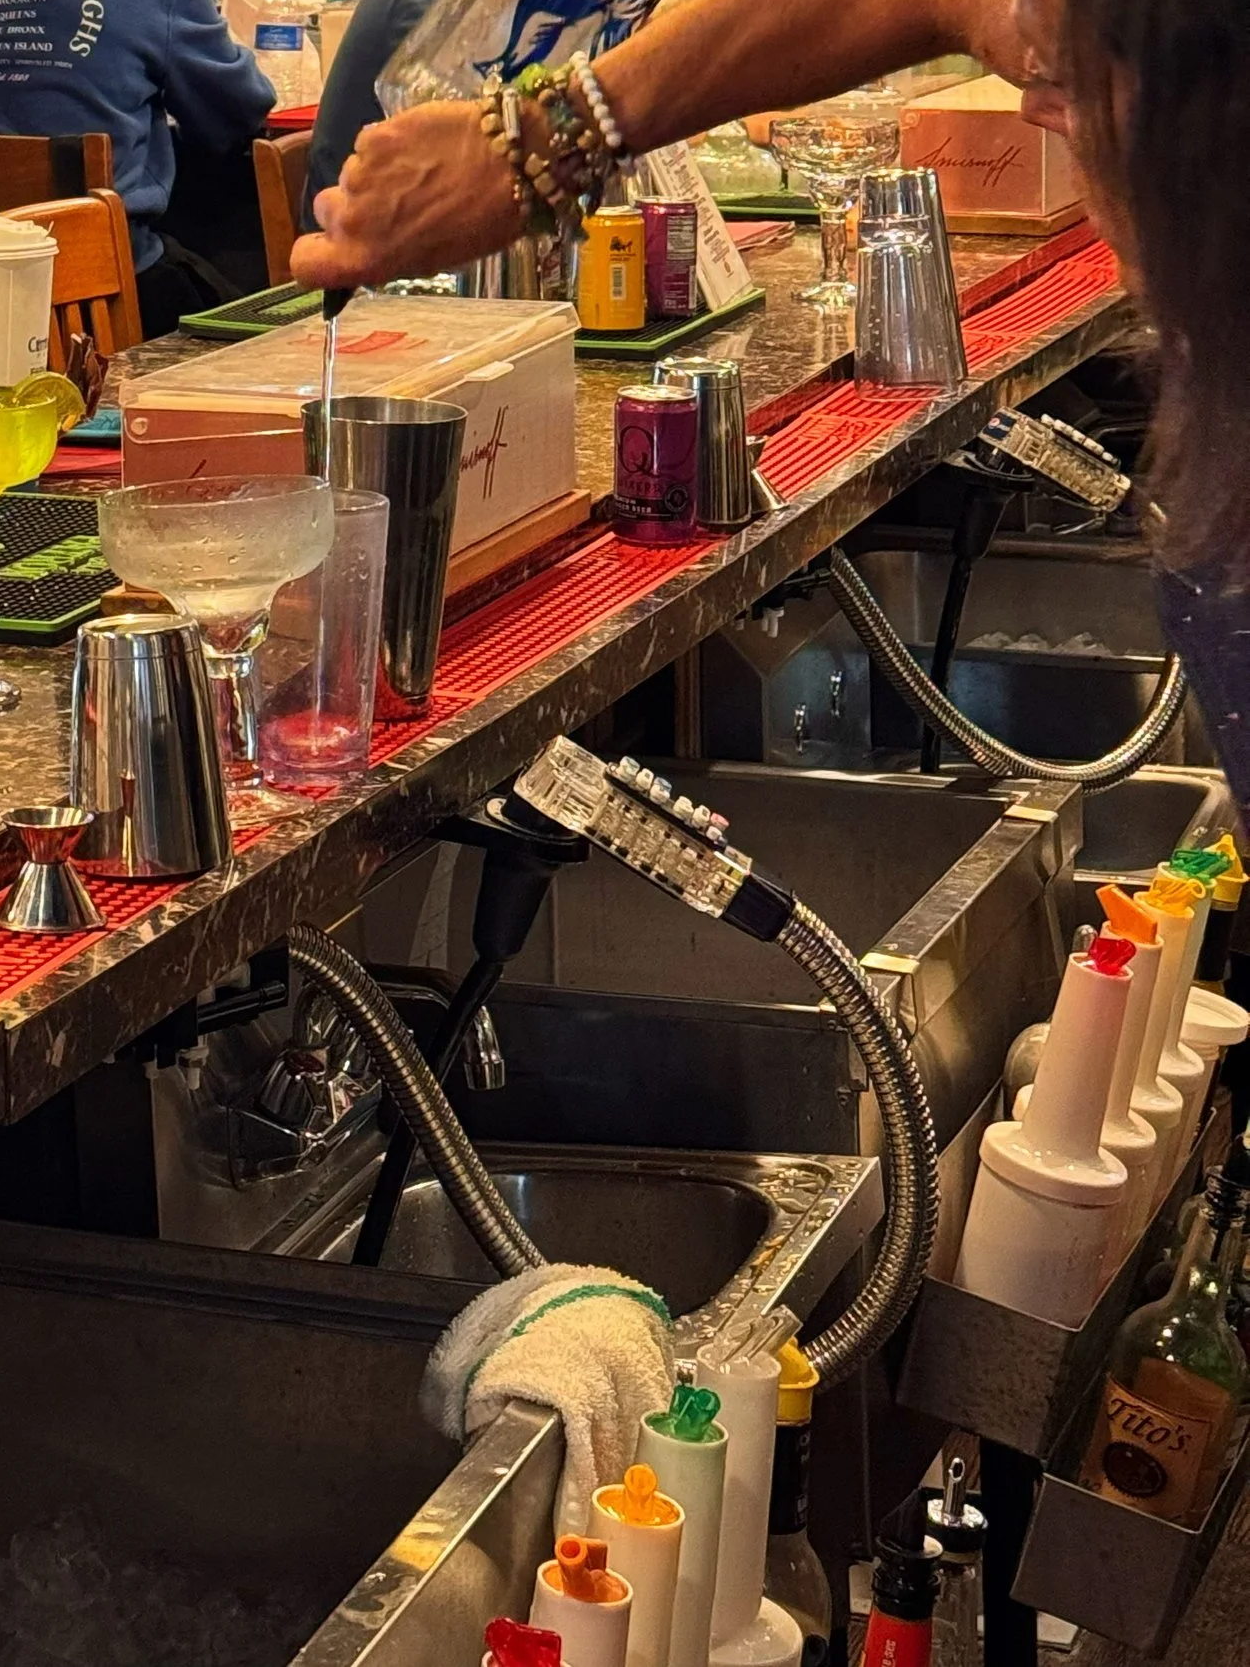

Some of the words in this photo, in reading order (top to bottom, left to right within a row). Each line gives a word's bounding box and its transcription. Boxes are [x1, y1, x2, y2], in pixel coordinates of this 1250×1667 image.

[6, 25, 46, 35] BRONX
[13, 41, 54, 52] ISLAND
[913, 136, 1027, 188] Smirnoff
[618, 425, 661, 478] Q
[1107, 1398, 1193, 1452] Tito's
